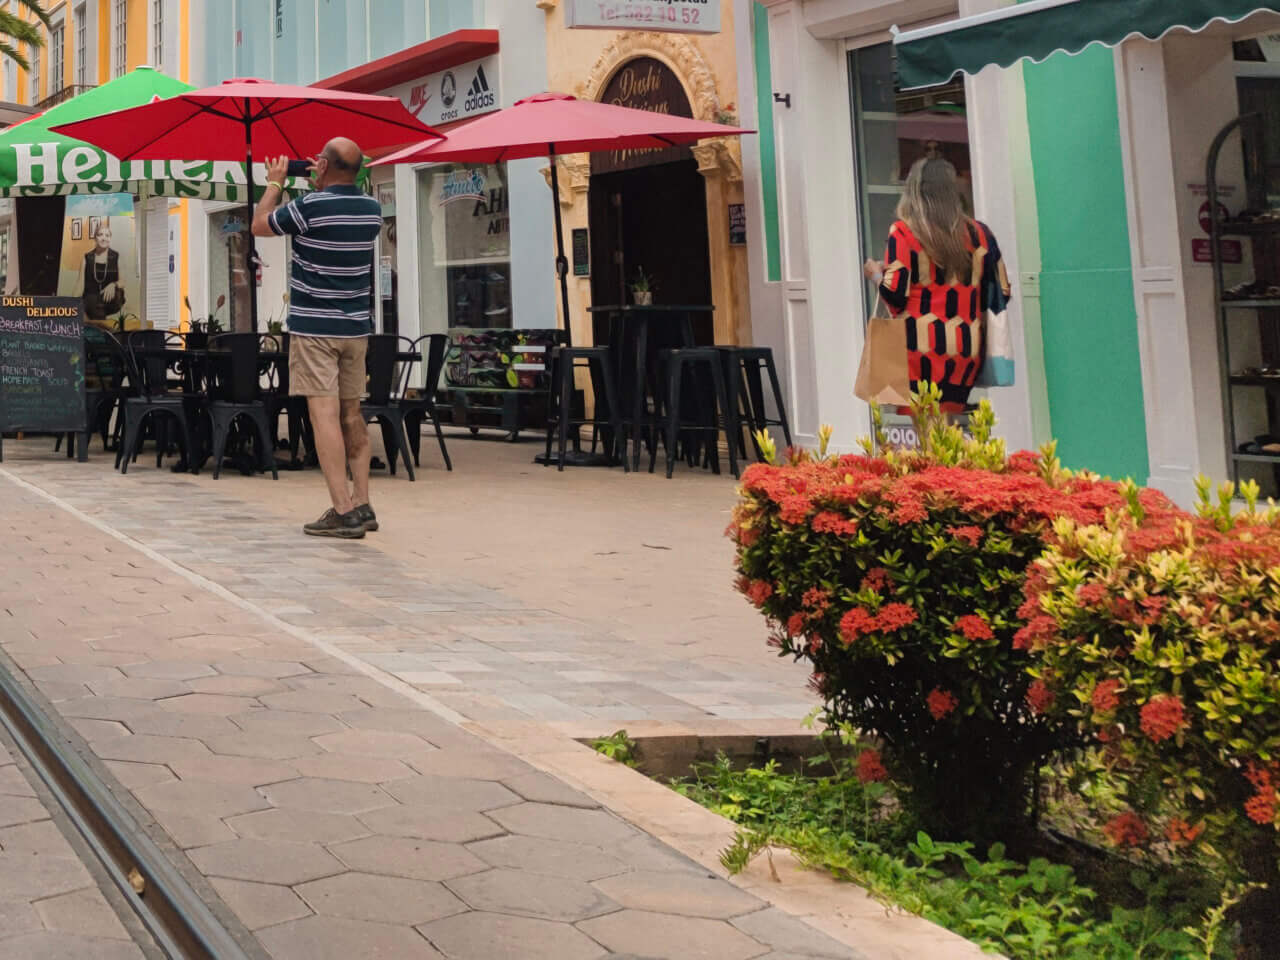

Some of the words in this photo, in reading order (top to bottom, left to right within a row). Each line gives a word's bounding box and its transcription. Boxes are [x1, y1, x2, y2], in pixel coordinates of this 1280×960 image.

[682, 7, 701, 25] 52
[620, 65, 662, 101] Dushi
[464, 90, 495, 112] adidas
[440, 109, 459, 121] crocs
[2, 296, 34, 307] DUSHI
[26, 307, 79, 317] DELICIOUS
[49, 319, 81, 336] LUNCH
[0, 365, 28, 377] FRENCH
[30, 367, 55, 378] TOAST
